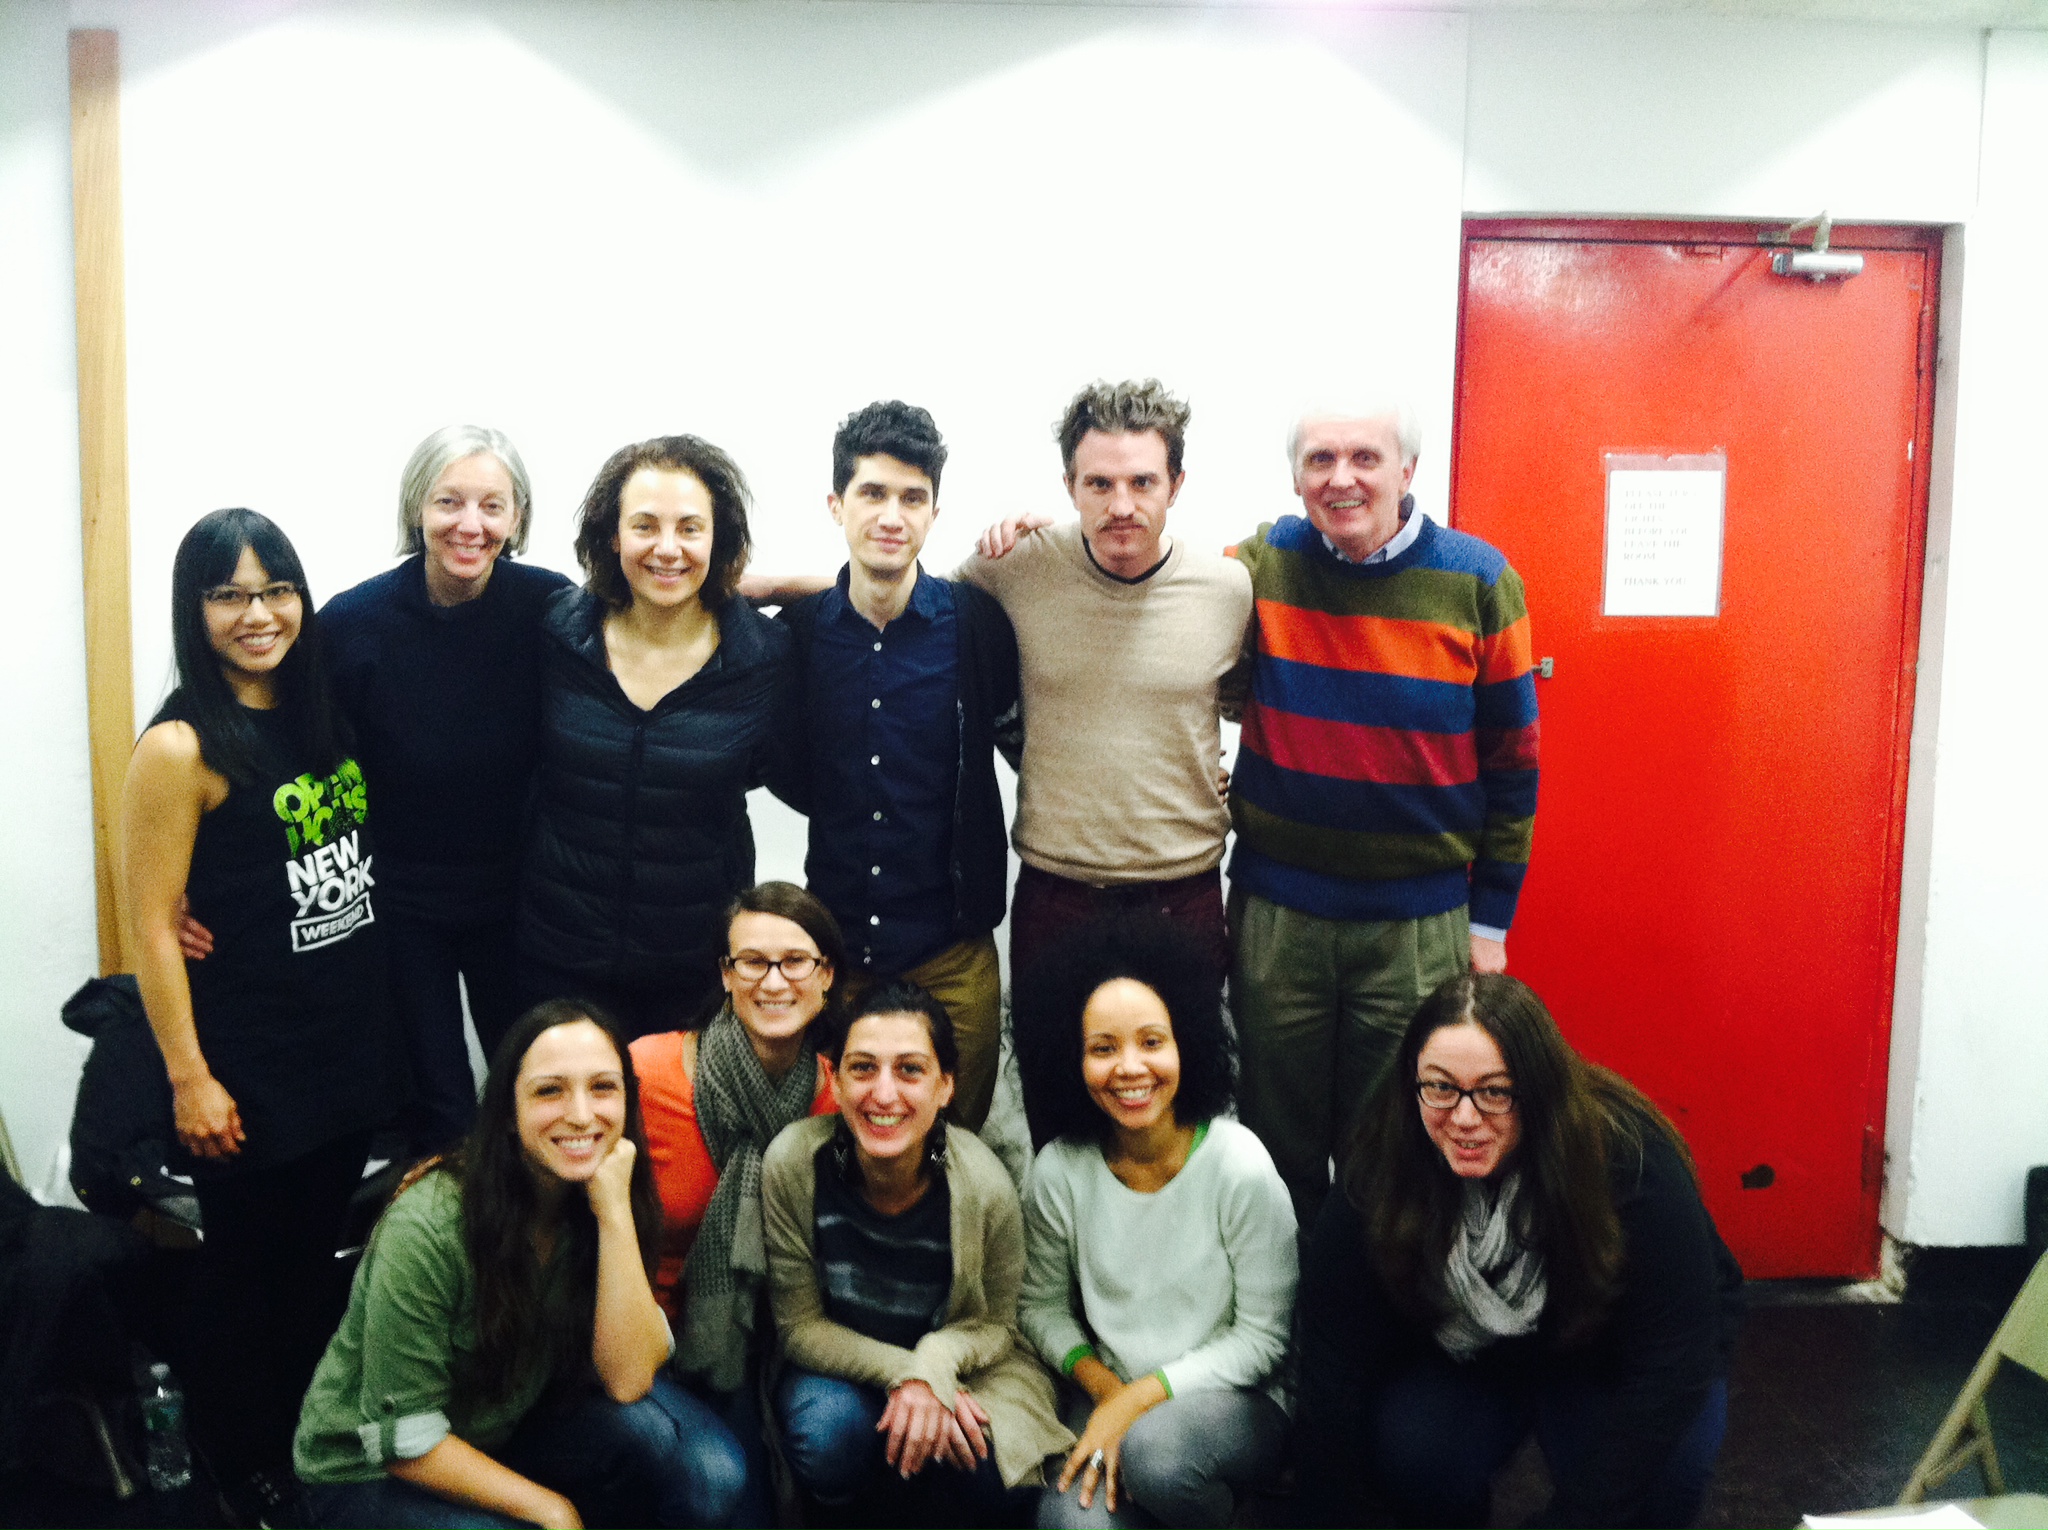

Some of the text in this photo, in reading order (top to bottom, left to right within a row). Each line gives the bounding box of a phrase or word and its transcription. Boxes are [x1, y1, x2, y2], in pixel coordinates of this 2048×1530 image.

[1623, 577, 1660, 587] THANK
[285, 829, 359, 892] NEW
[291, 855, 375, 917] YORK
